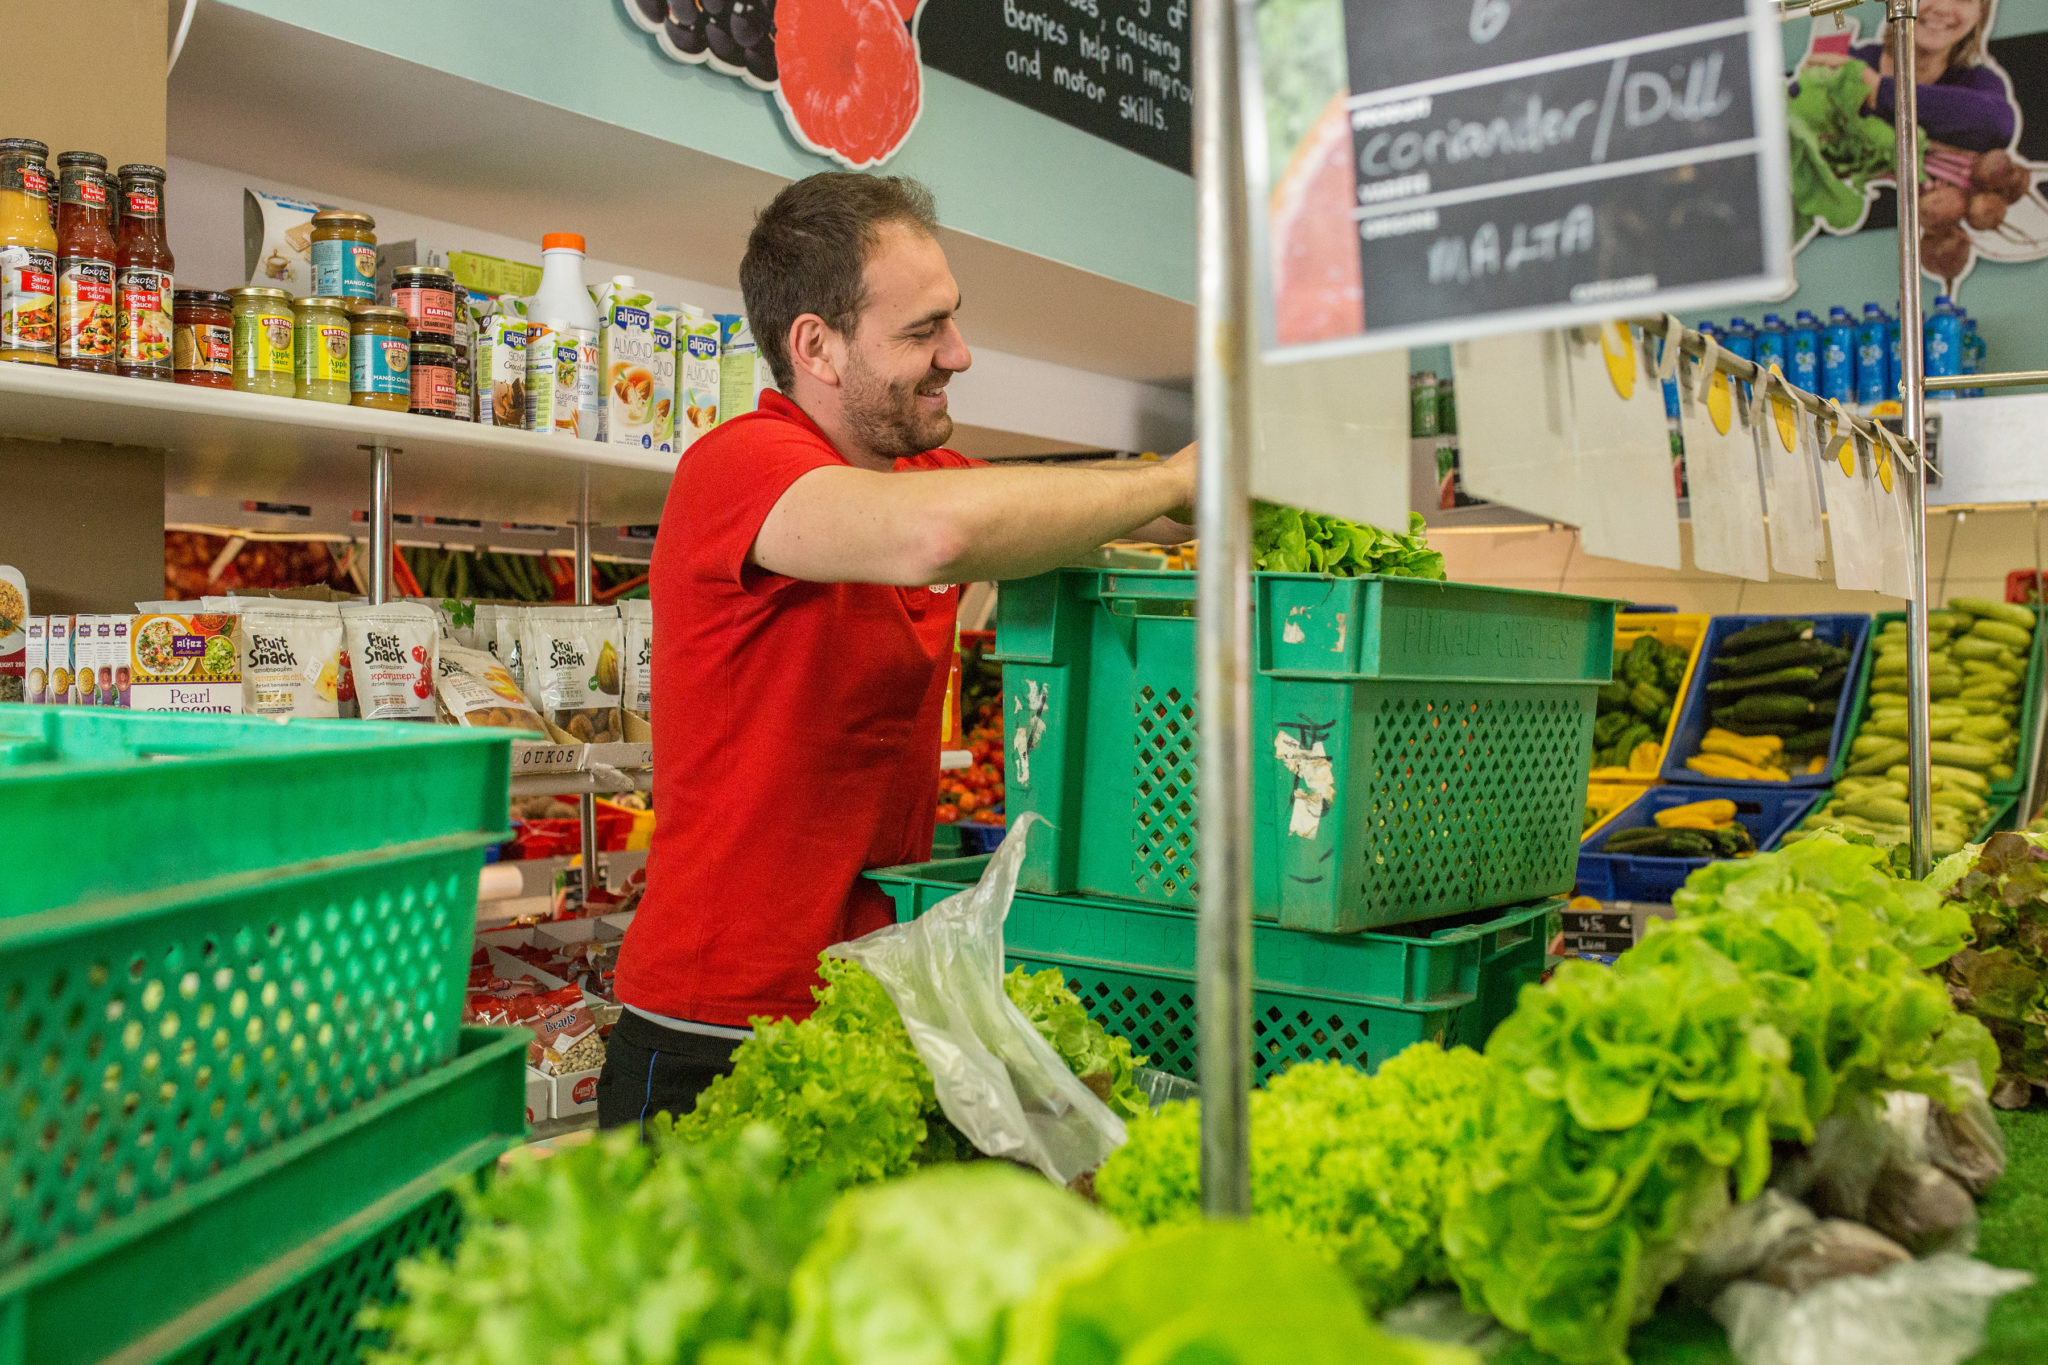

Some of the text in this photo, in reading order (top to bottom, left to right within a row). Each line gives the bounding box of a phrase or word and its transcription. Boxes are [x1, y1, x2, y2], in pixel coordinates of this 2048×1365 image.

[1004, 0, 1068, 45] Berries
[1080, 30, 1110, 74] help
[1116, 45, 1133, 75] in
[1116, 16, 1180, 72] causing
[1006, 49, 1168, 131] and motor skills.
[1427, 203, 1594, 286] MALTA
[31, 275, 50, 285] Satay
[31, 283, 51, 292] Sauce
[128, 275, 156, 285] Exotic
[344, 279, 366, 287] MANGO
[78, 284, 98, 293] Sweet
[88, 292, 105, 301] Sauce
[264, 318, 293, 329] BARTONS
[618, 310, 647, 329] alpro
[507, 334, 527, 346] alpro
[614, 337, 652, 359] ALMOND
[690, 337, 715, 354] alpro
[271, 349, 290, 359] Apple
[272, 357, 289, 366] Sauce
[558, 348, 576, 361] alpro
[329, 359, 348, 369] Apple
[687, 364, 719, 385] ALMOND
[252, 635, 288, 651] Fruit
[367, 632, 400, 650] Fruit
[551, 639, 574, 654] Frui
[248, 648, 298, 668] Snack
[364, 646, 407, 664] Snack
[550, 652, 586, 669] Snack
[170, 688, 211, 704] Pearl
[545, 1013, 576, 1033] Beans
